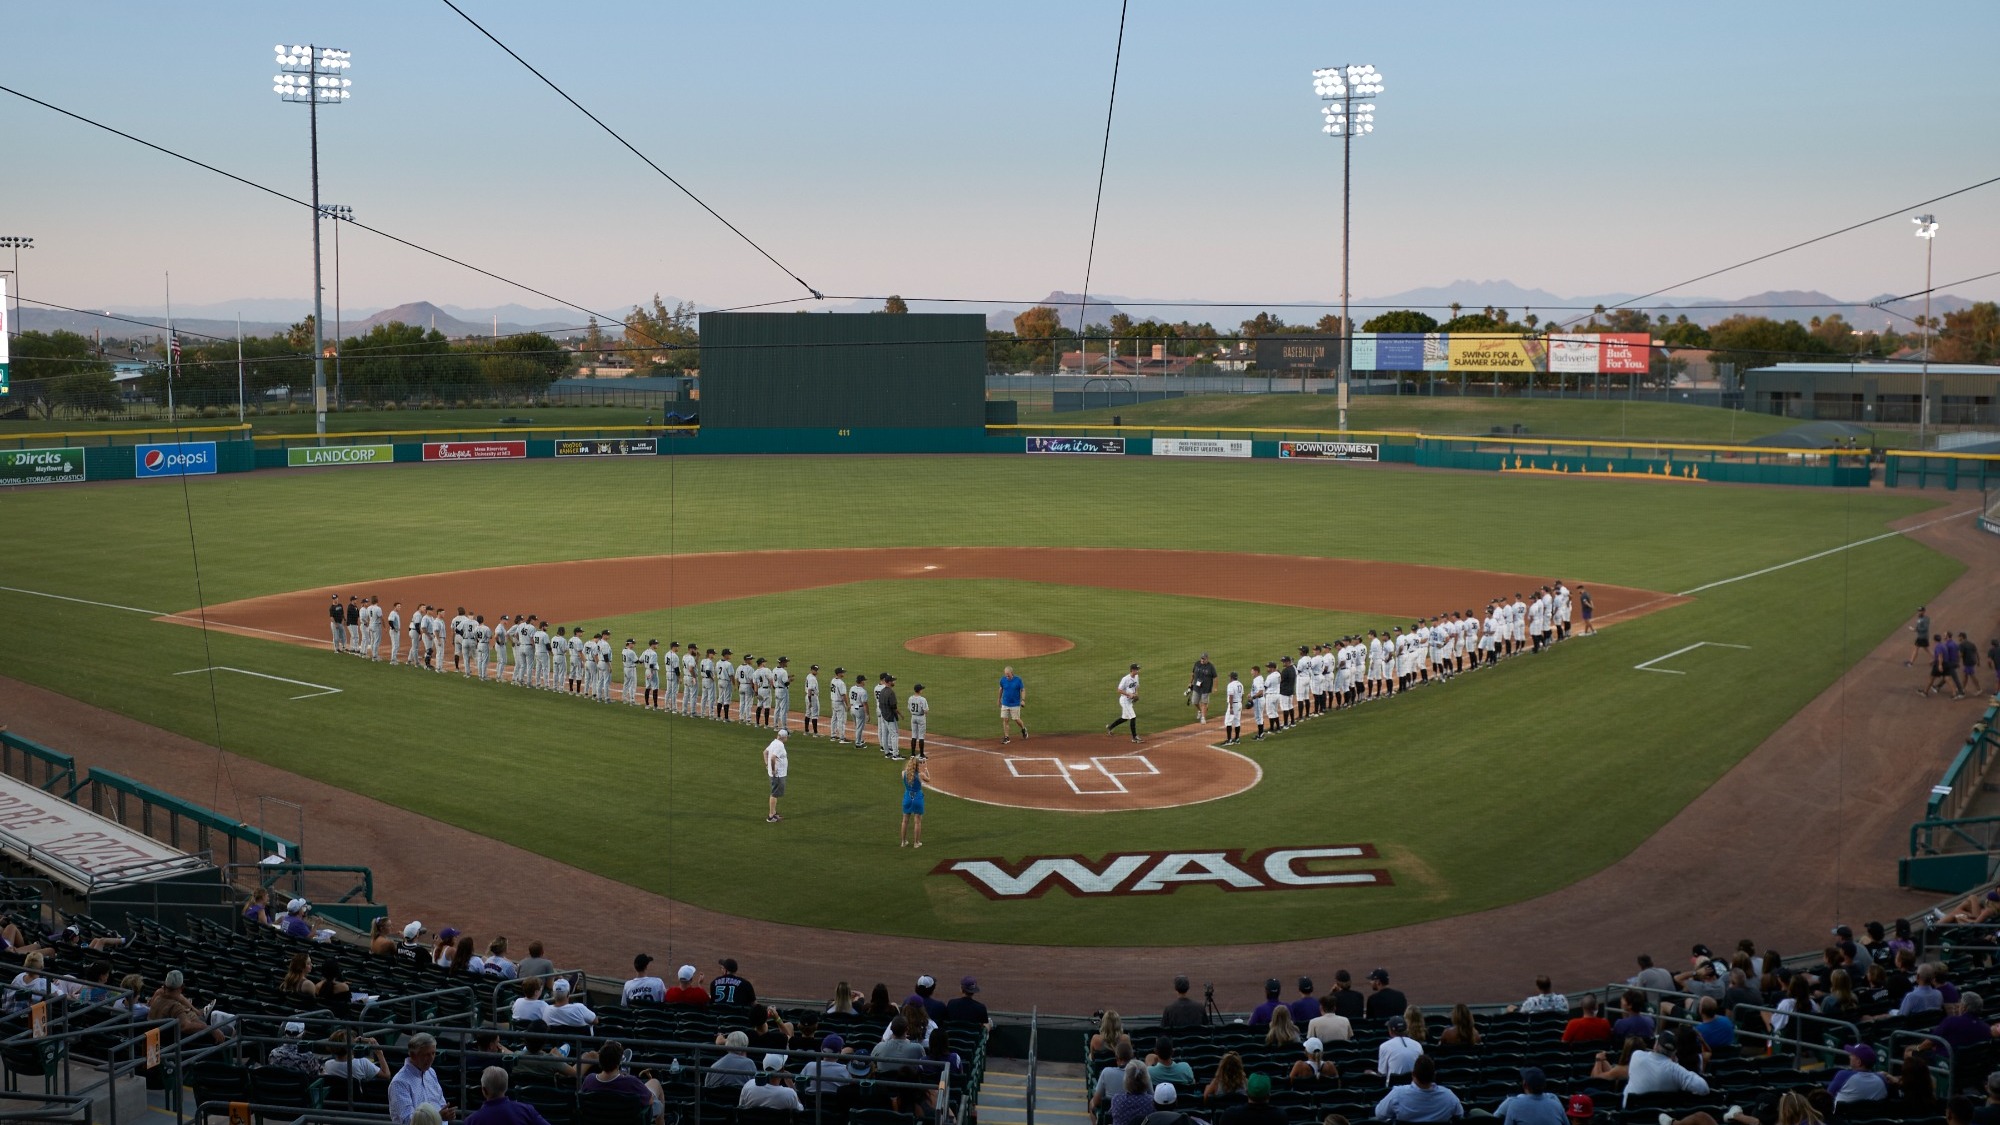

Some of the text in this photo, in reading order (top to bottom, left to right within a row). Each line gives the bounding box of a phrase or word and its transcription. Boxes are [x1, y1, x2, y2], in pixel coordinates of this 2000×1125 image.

[1462, 351, 1518, 359] SWING FOR A
[1454, 358, 1525, 366] SUMMER SHANDY
[1606, 358, 1622, 368] For
[1050, 440, 1098, 452] turn it on
[15, 452, 61, 465] Dircks
[167, 450, 207, 468] pepsi
[306, 448, 376, 463] LANDCORP
[35, 465, 63, 473] Mayflower
[26, 475, 52, 483] STORAGE
[911, 703, 919, 712] 31
[938, 845, 1388, 898] WAC
[715, 986, 735, 1003] 51
